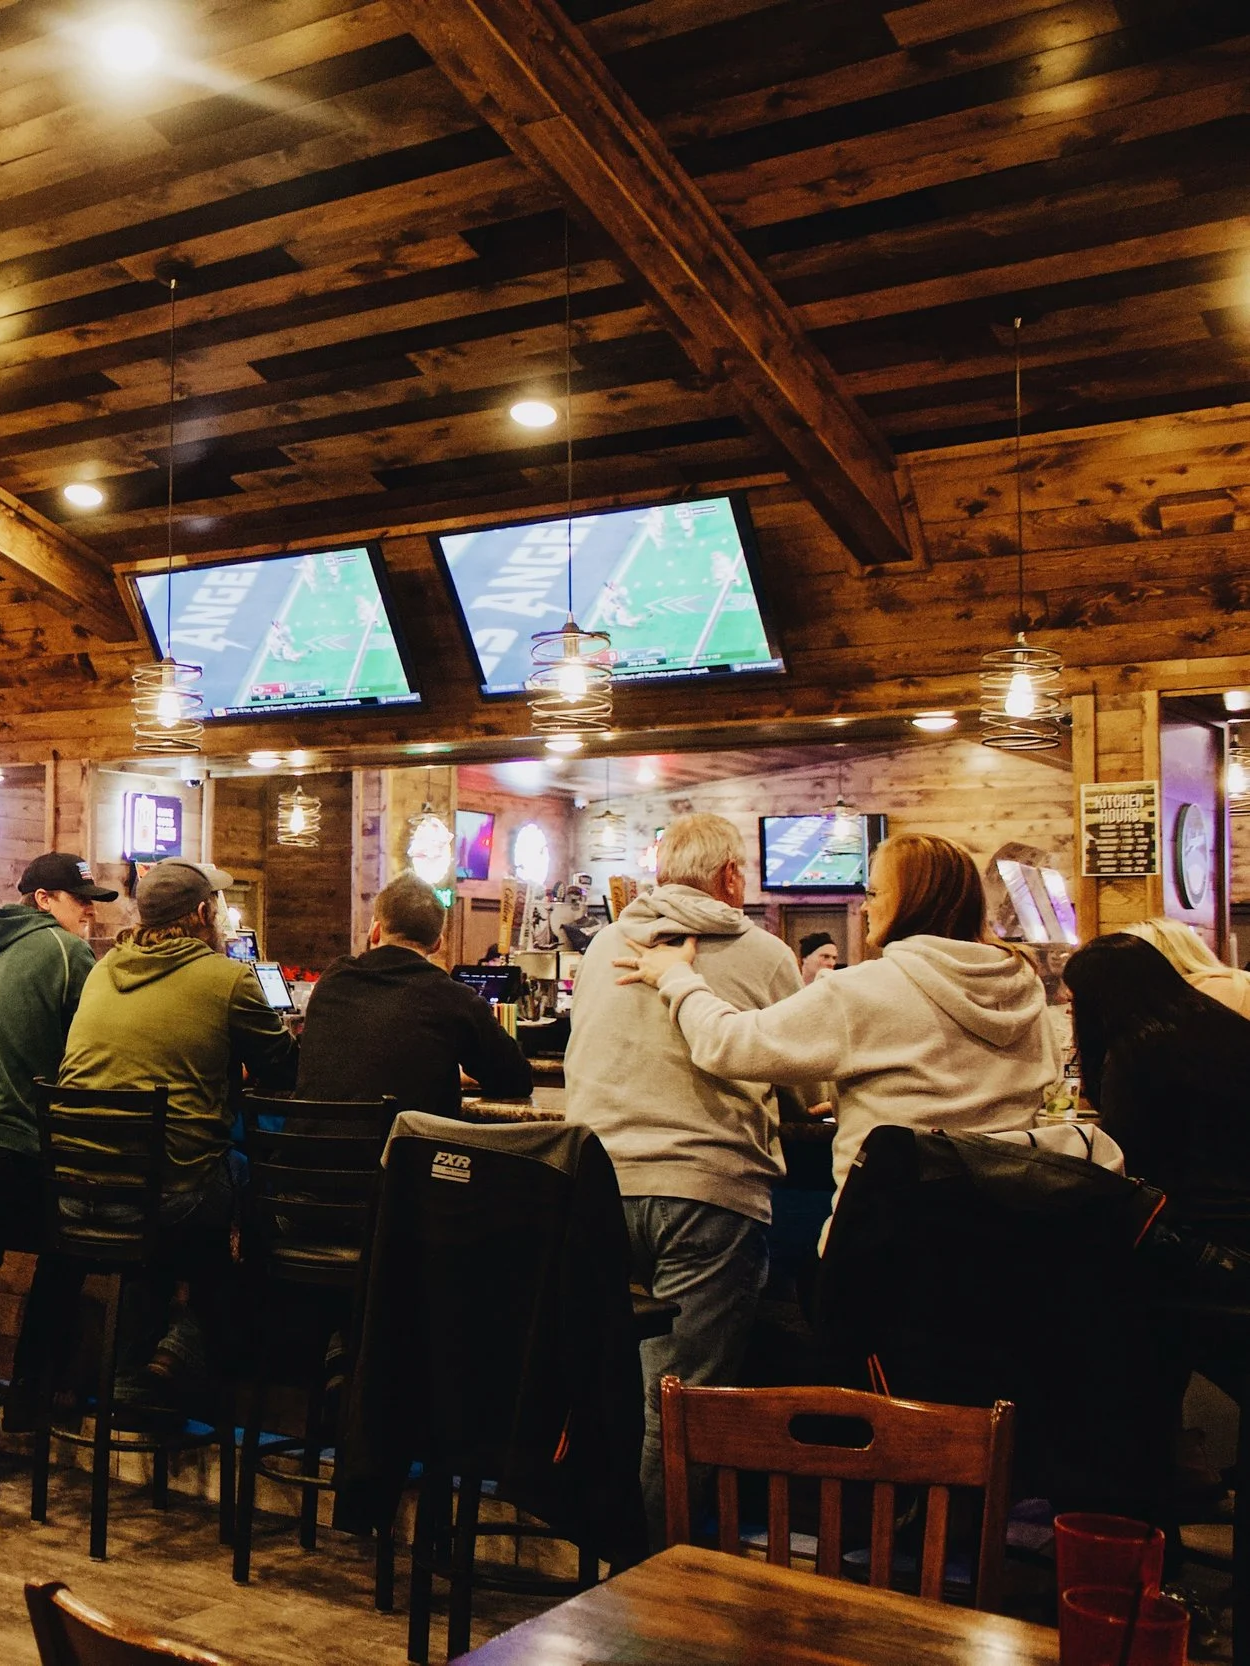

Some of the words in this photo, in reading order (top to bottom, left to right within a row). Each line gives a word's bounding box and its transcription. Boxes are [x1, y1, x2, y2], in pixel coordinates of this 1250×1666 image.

[1094, 793, 1145, 809] KITCHEN
[1100, 808, 1140, 823] HOURS
[433, 1151, 472, 1169] FXR
